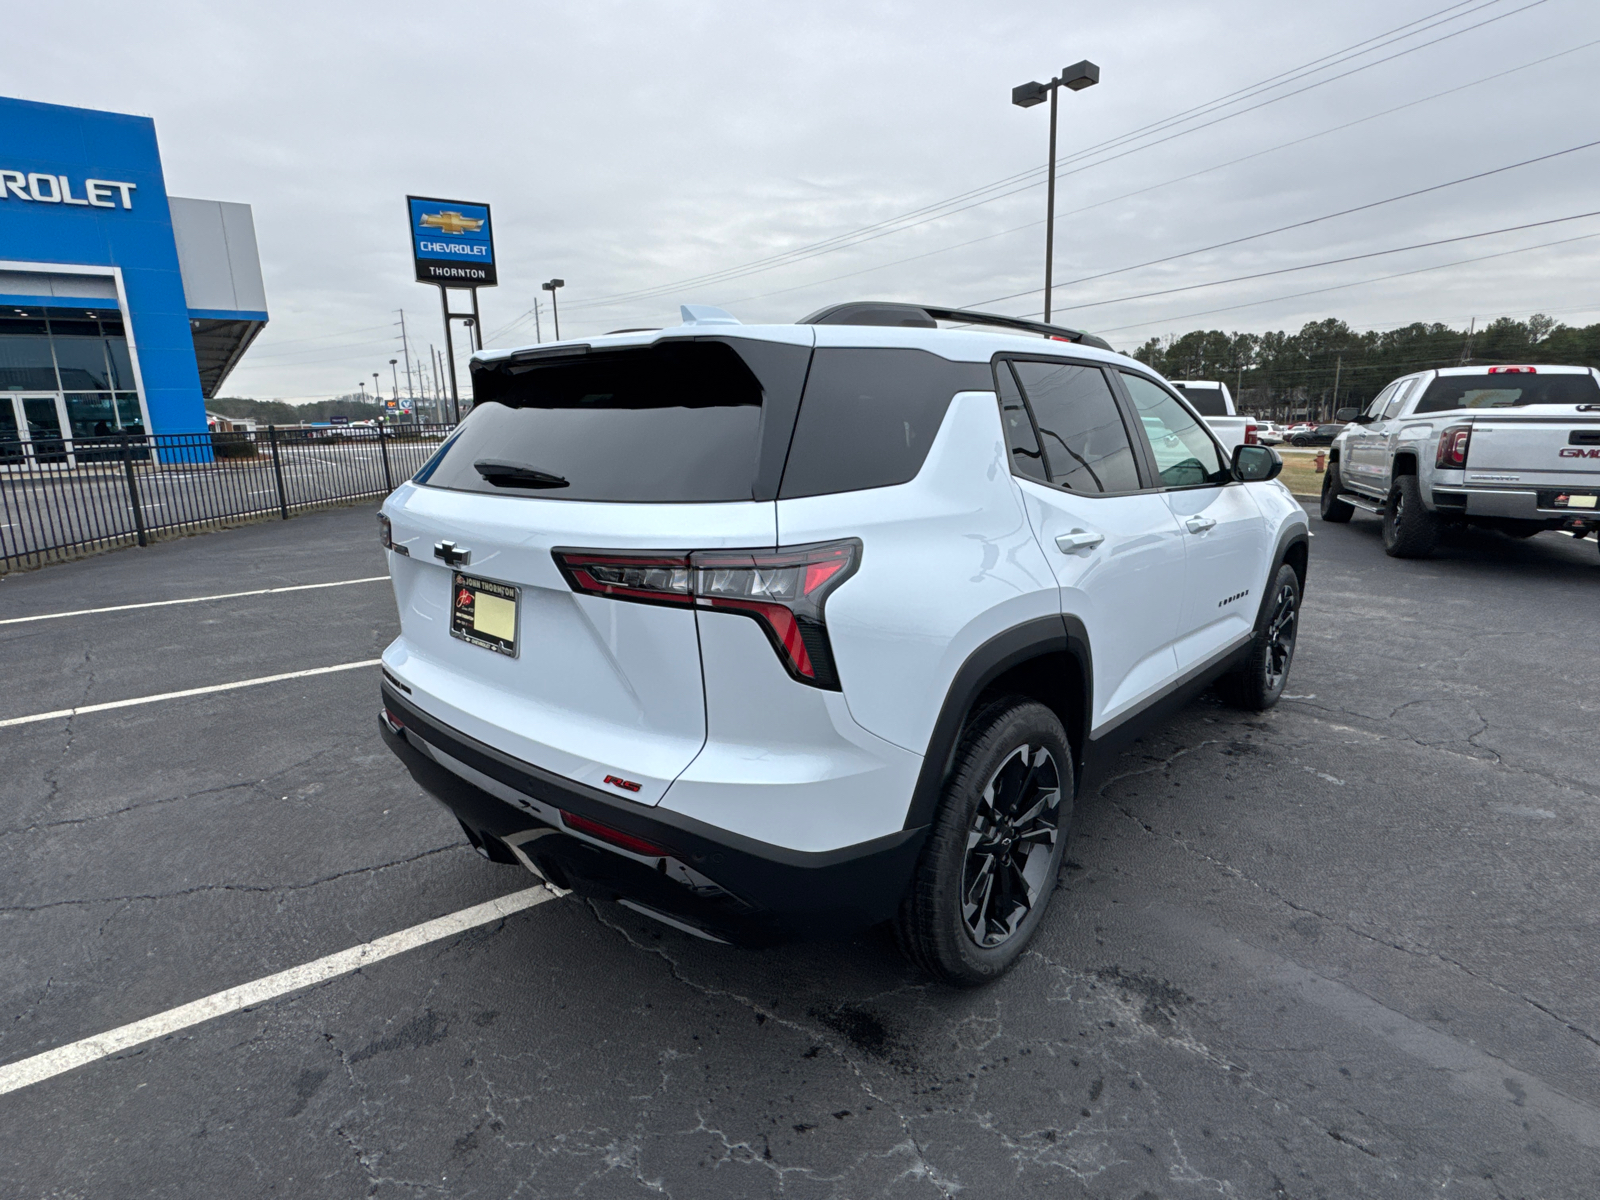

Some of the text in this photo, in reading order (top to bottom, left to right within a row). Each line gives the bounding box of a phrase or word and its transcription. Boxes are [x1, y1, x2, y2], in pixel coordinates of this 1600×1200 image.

[420, 241, 487, 256] CHEVROLET
[429, 266, 486, 278] THORNTON
[465, 578, 515, 597] JOHN THORNTON
[603, 774, 642, 792] RS
